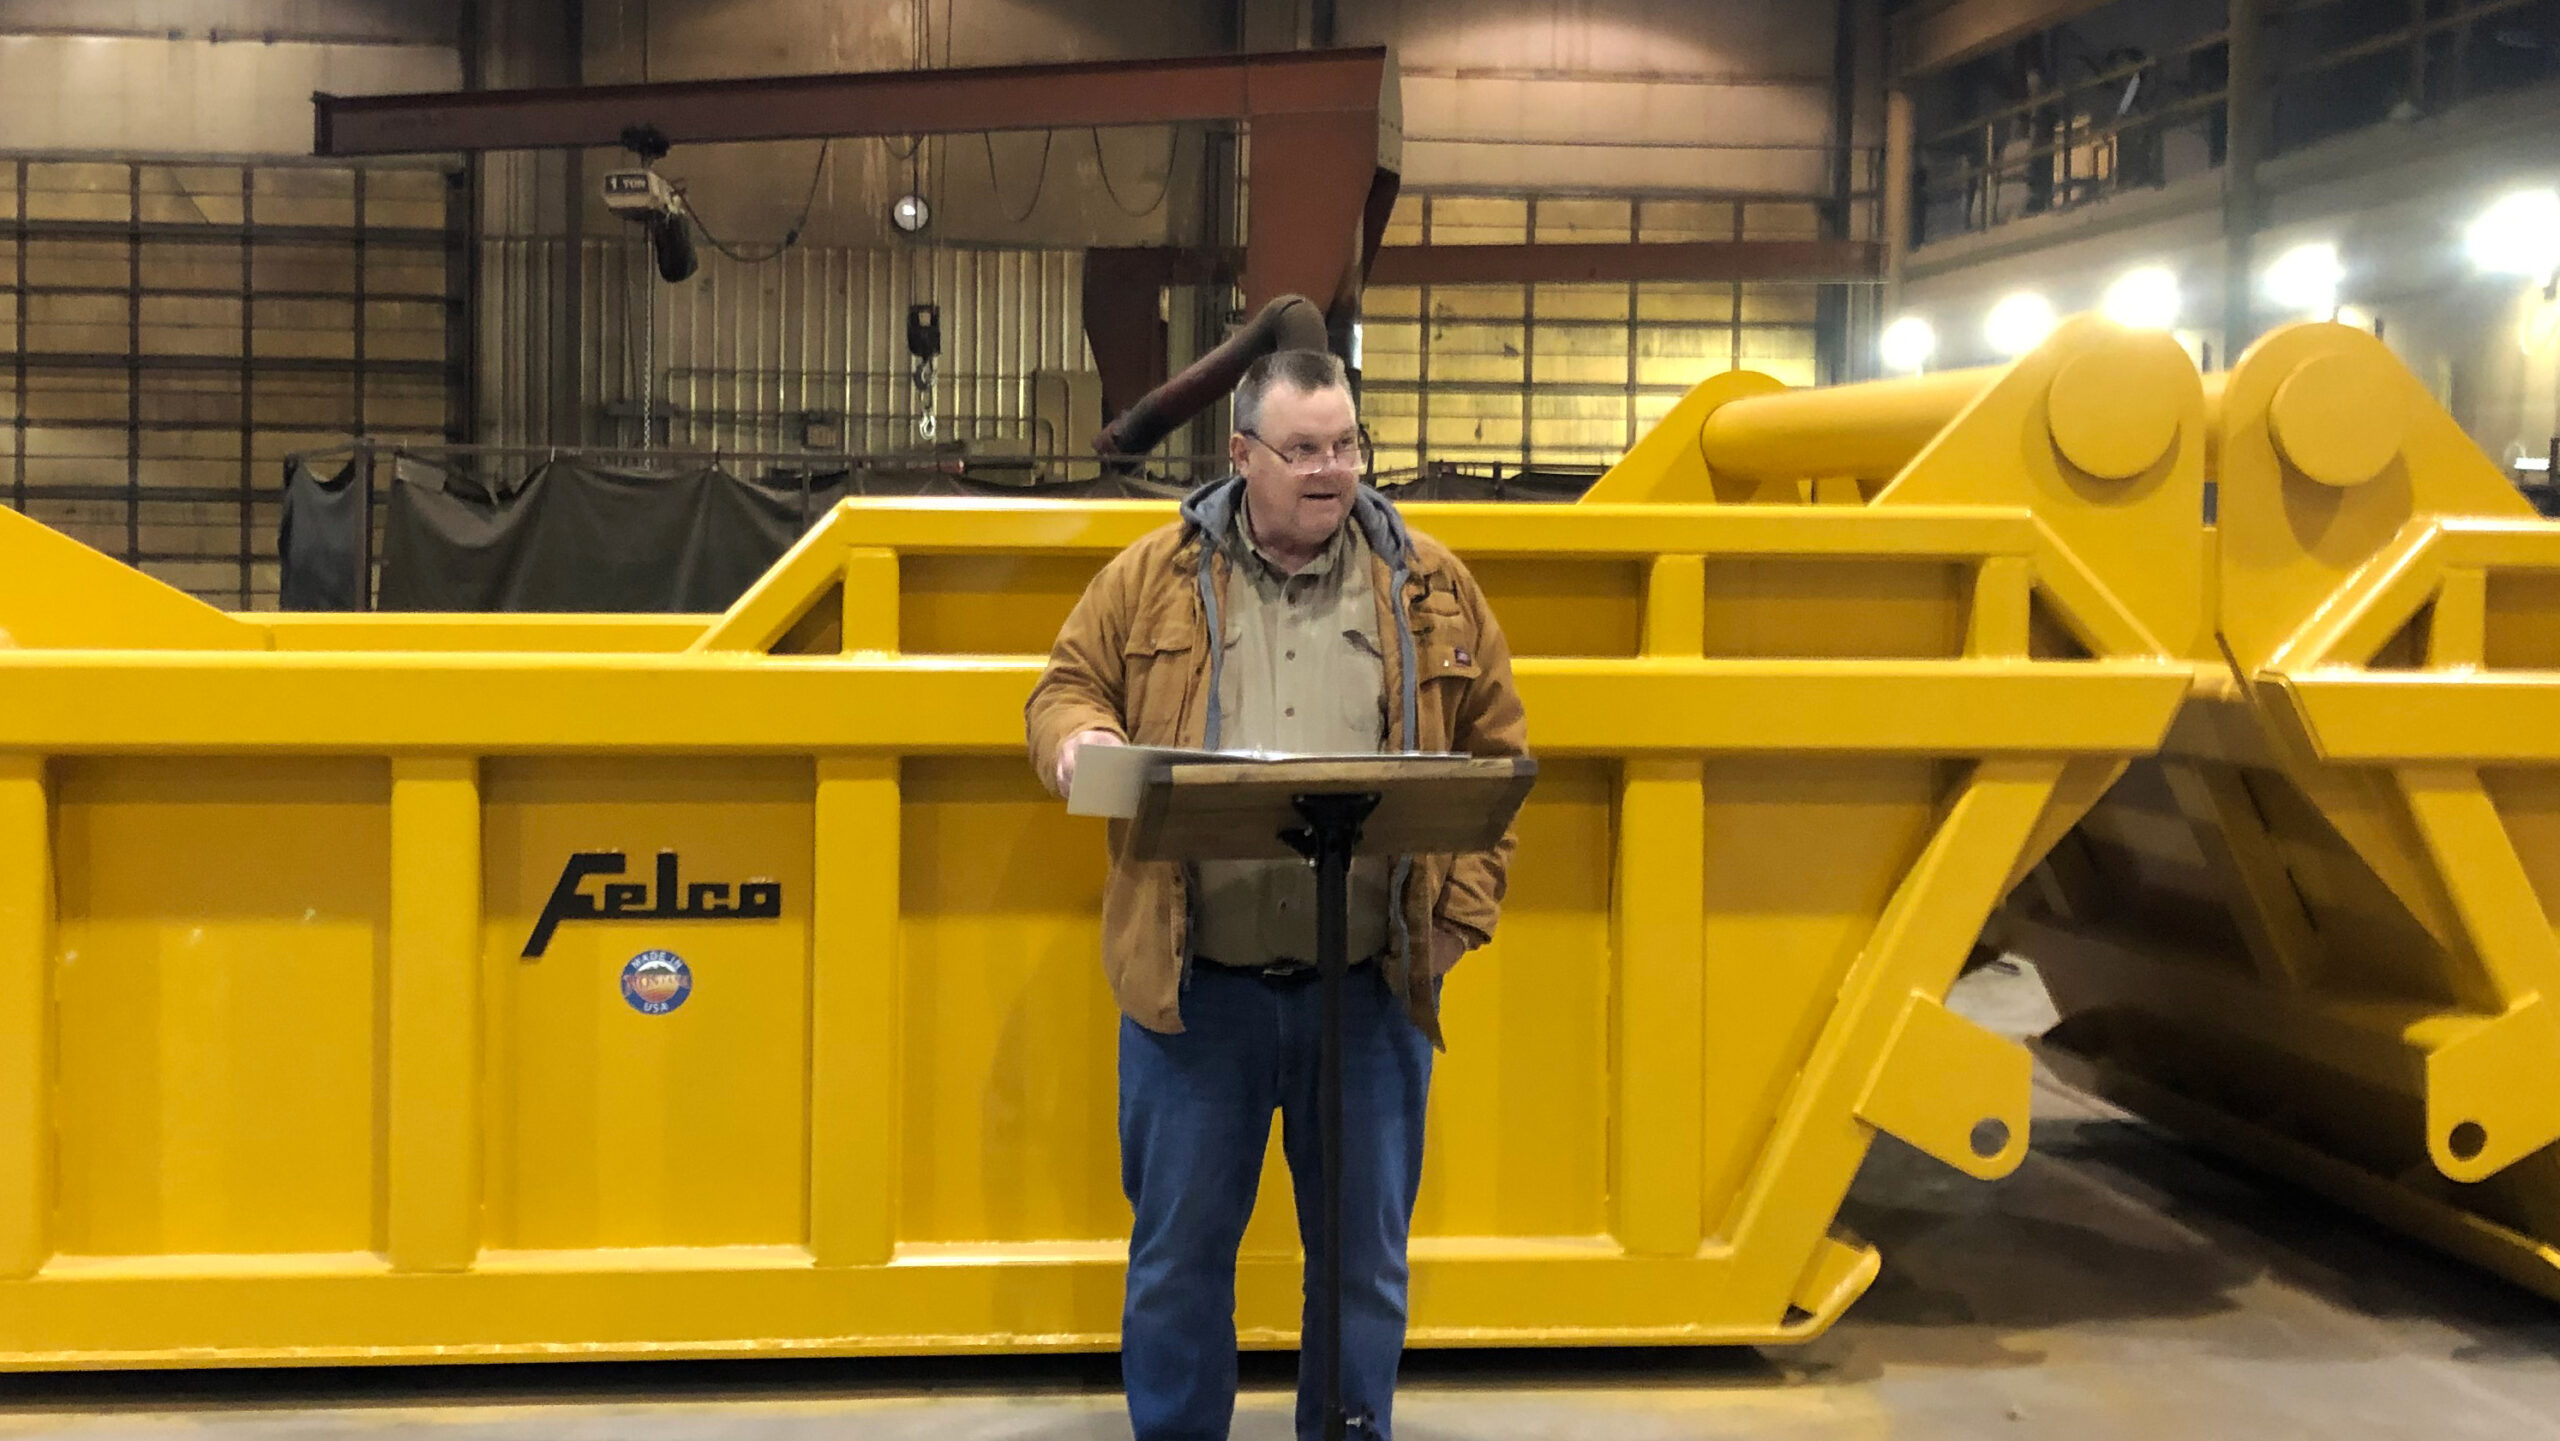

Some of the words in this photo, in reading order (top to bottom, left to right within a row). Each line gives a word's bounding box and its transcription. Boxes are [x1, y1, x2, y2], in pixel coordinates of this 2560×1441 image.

[610, 177, 617, 190] 1
[521, 853, 781, 957] Felco
[631, 951, 667, 968] MADE
[669, 956, 683, 969] IN
[643, 1002, 669, 1013] USA
